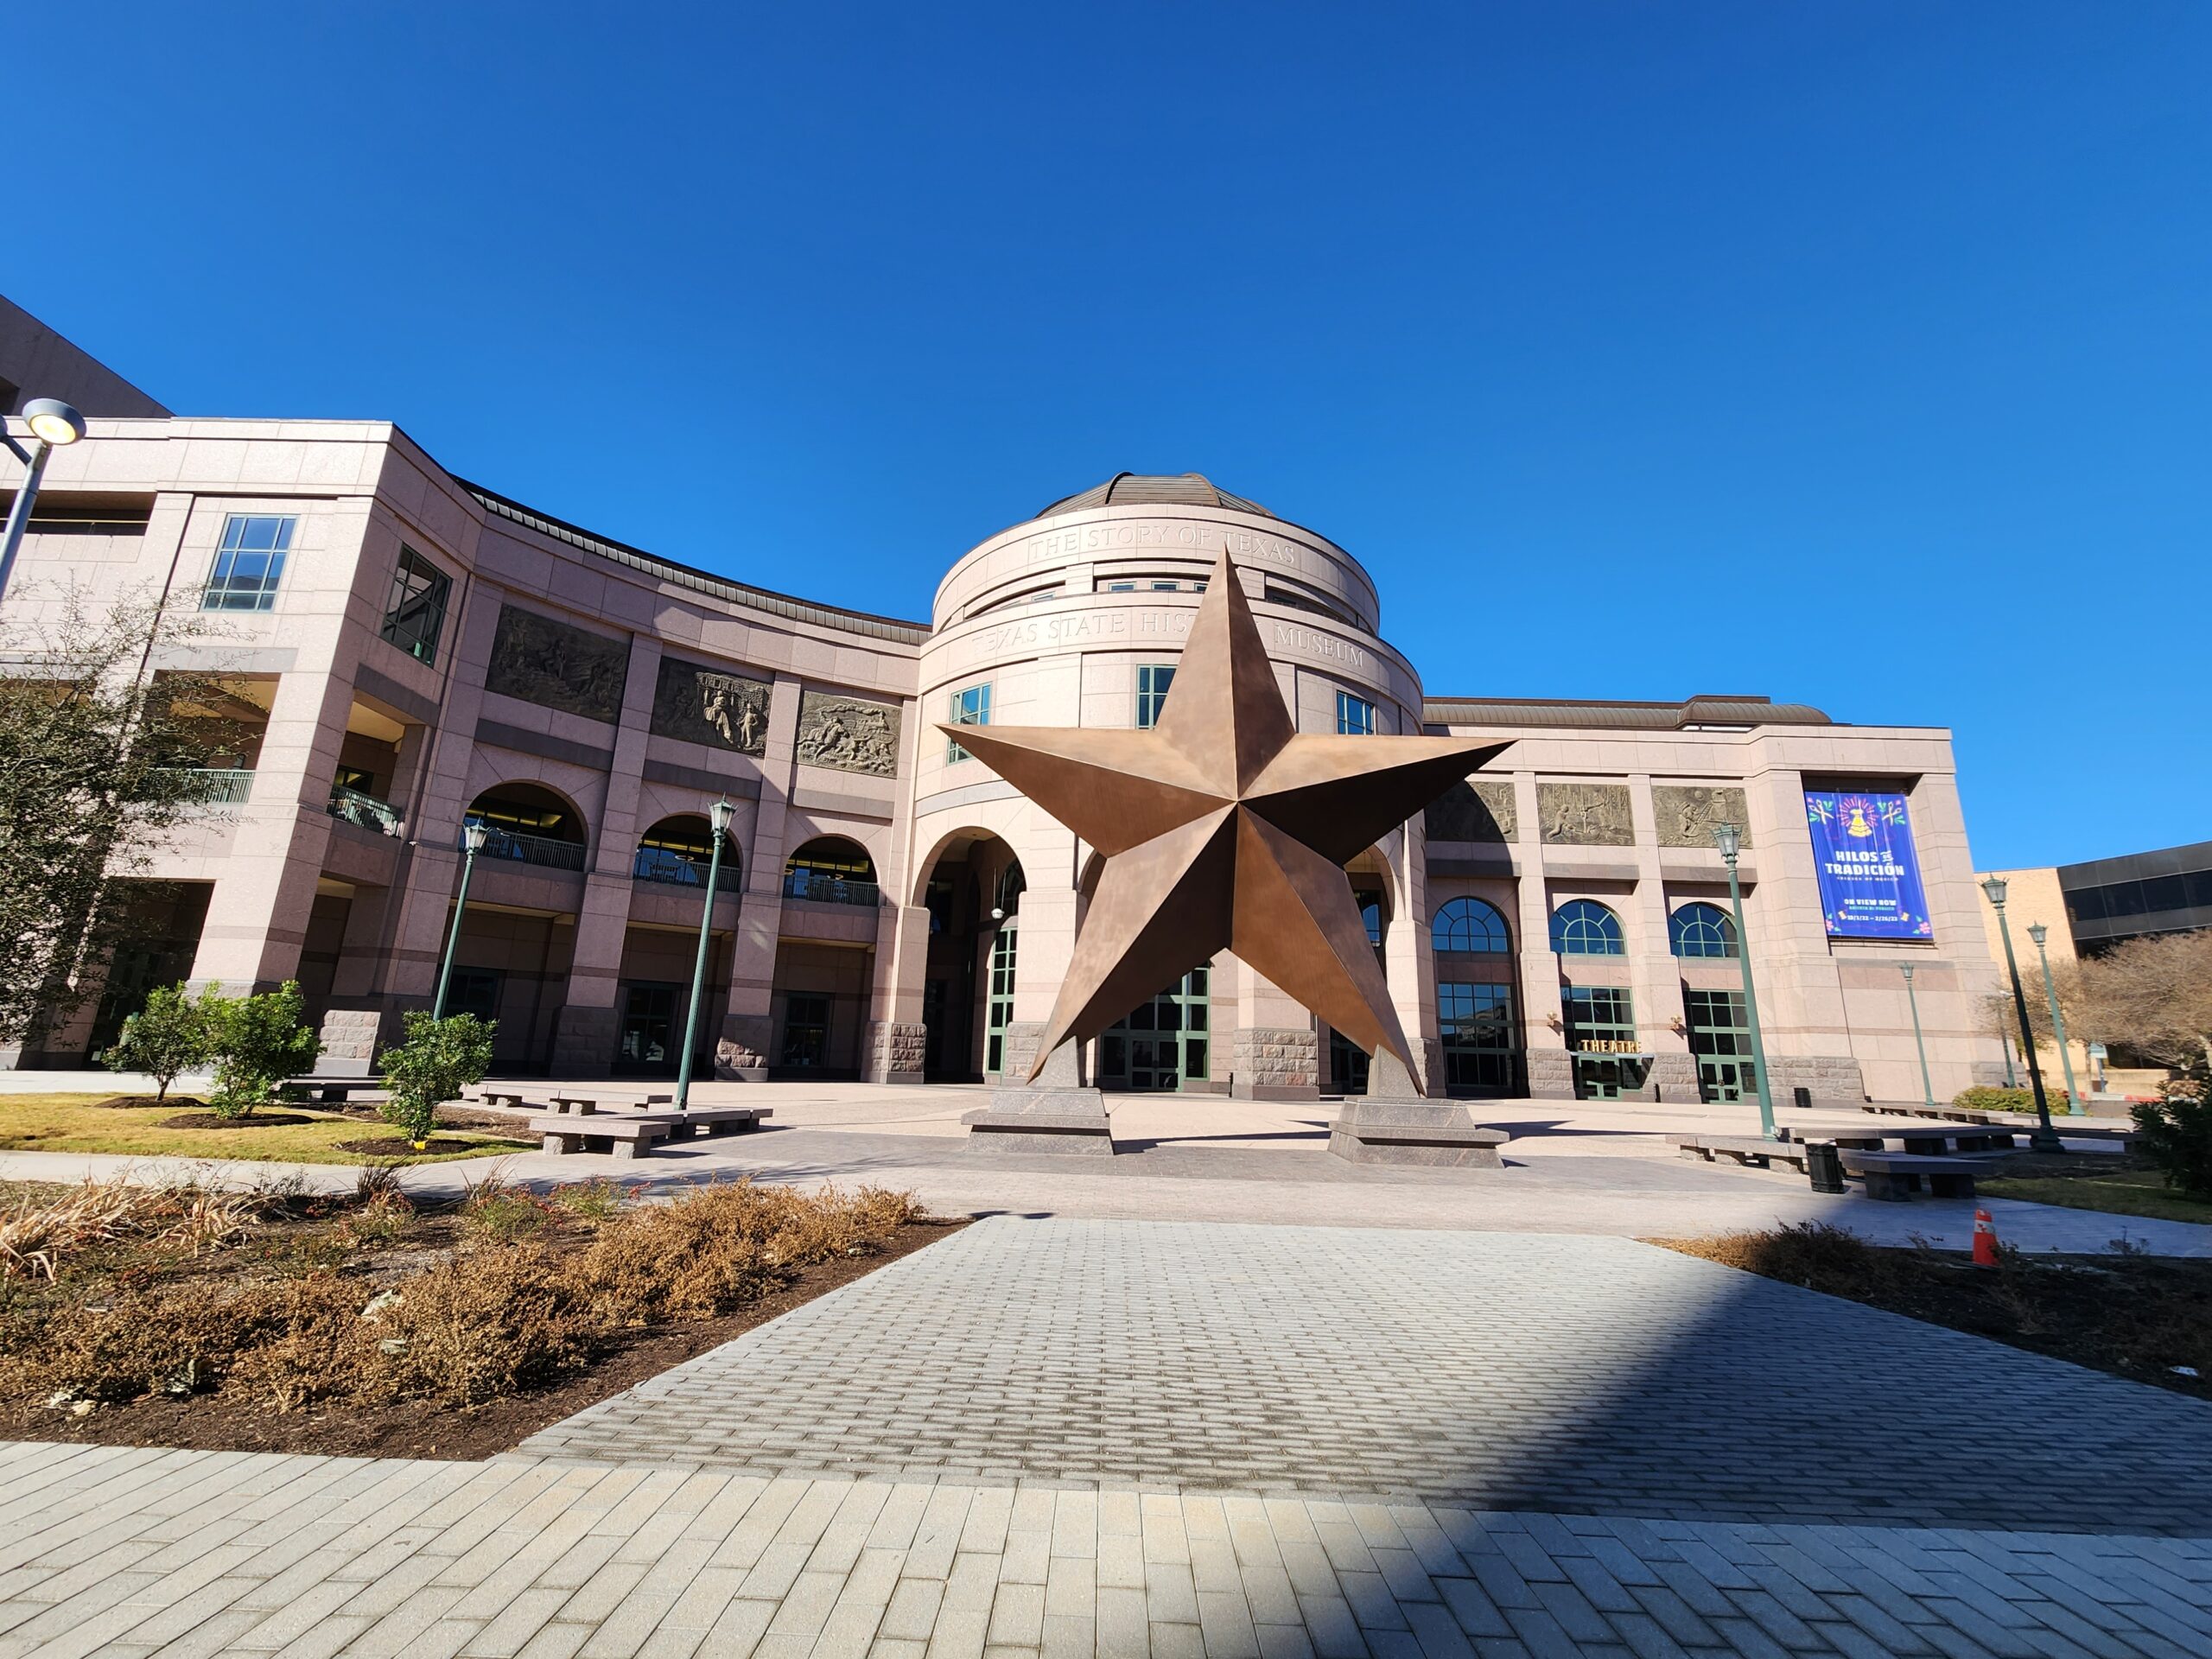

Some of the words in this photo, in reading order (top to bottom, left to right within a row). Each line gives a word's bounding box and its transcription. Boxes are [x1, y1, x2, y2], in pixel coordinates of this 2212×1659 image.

[1030, 532, 1078, 559] THE
[1087, 525, 1170, 548] STORY
[1178, 526, 1211, 546] OF
[1220, 530, 1295, 564] TEXAS
[970, 623, 1039, 655] TEXAS
[1048, 613, 1126, 640] STATE
[1274, 624, 1363, 668] MUSEUM
[1835, 850, 1879, 862] HILOS
[1825, 862, 1904, 875] TRADICIÓN
[1580, 1039, 1643, 1053] THEATRE
